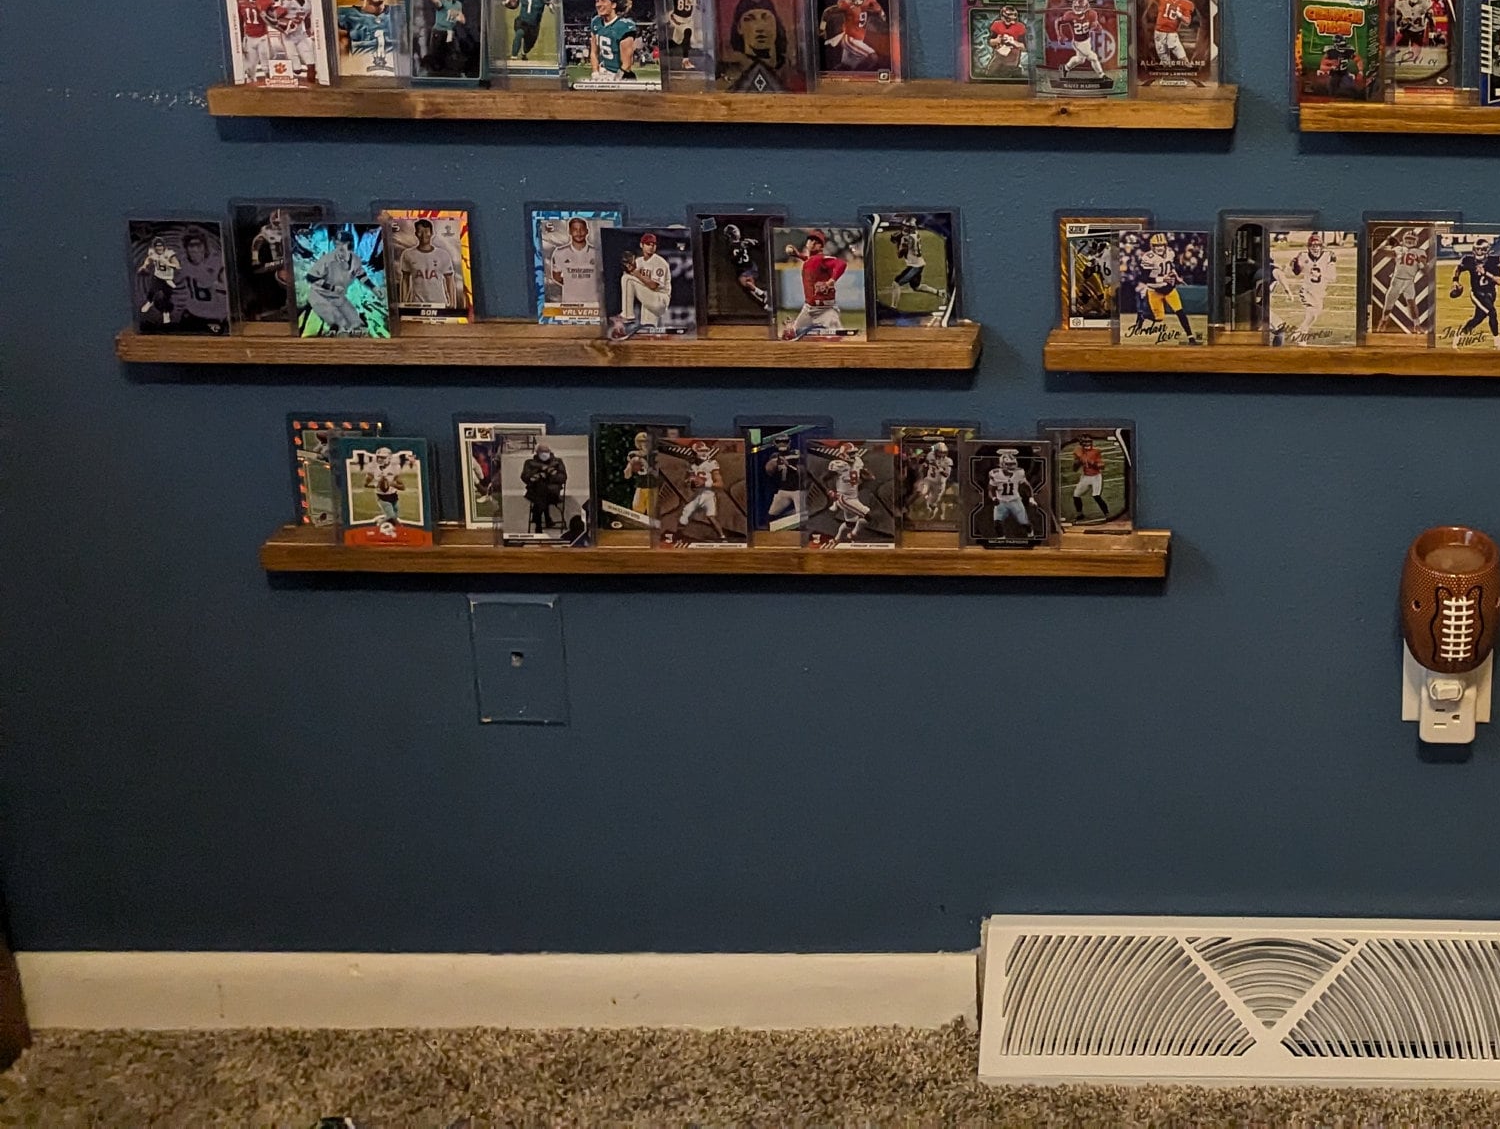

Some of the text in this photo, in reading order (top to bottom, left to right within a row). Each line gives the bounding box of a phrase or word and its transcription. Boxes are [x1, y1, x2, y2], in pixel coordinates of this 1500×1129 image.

[244, 8, 259, 24] 11
[858, 11, 868, 28] 9
[1073, 23, 1090, 35] 22
[415, 270, 438, 279] AIA
[1158, 261, 1172, 275] 10
[1155, 330, 1181, 344] Love
[1002, 482, 1014, 496] 11
